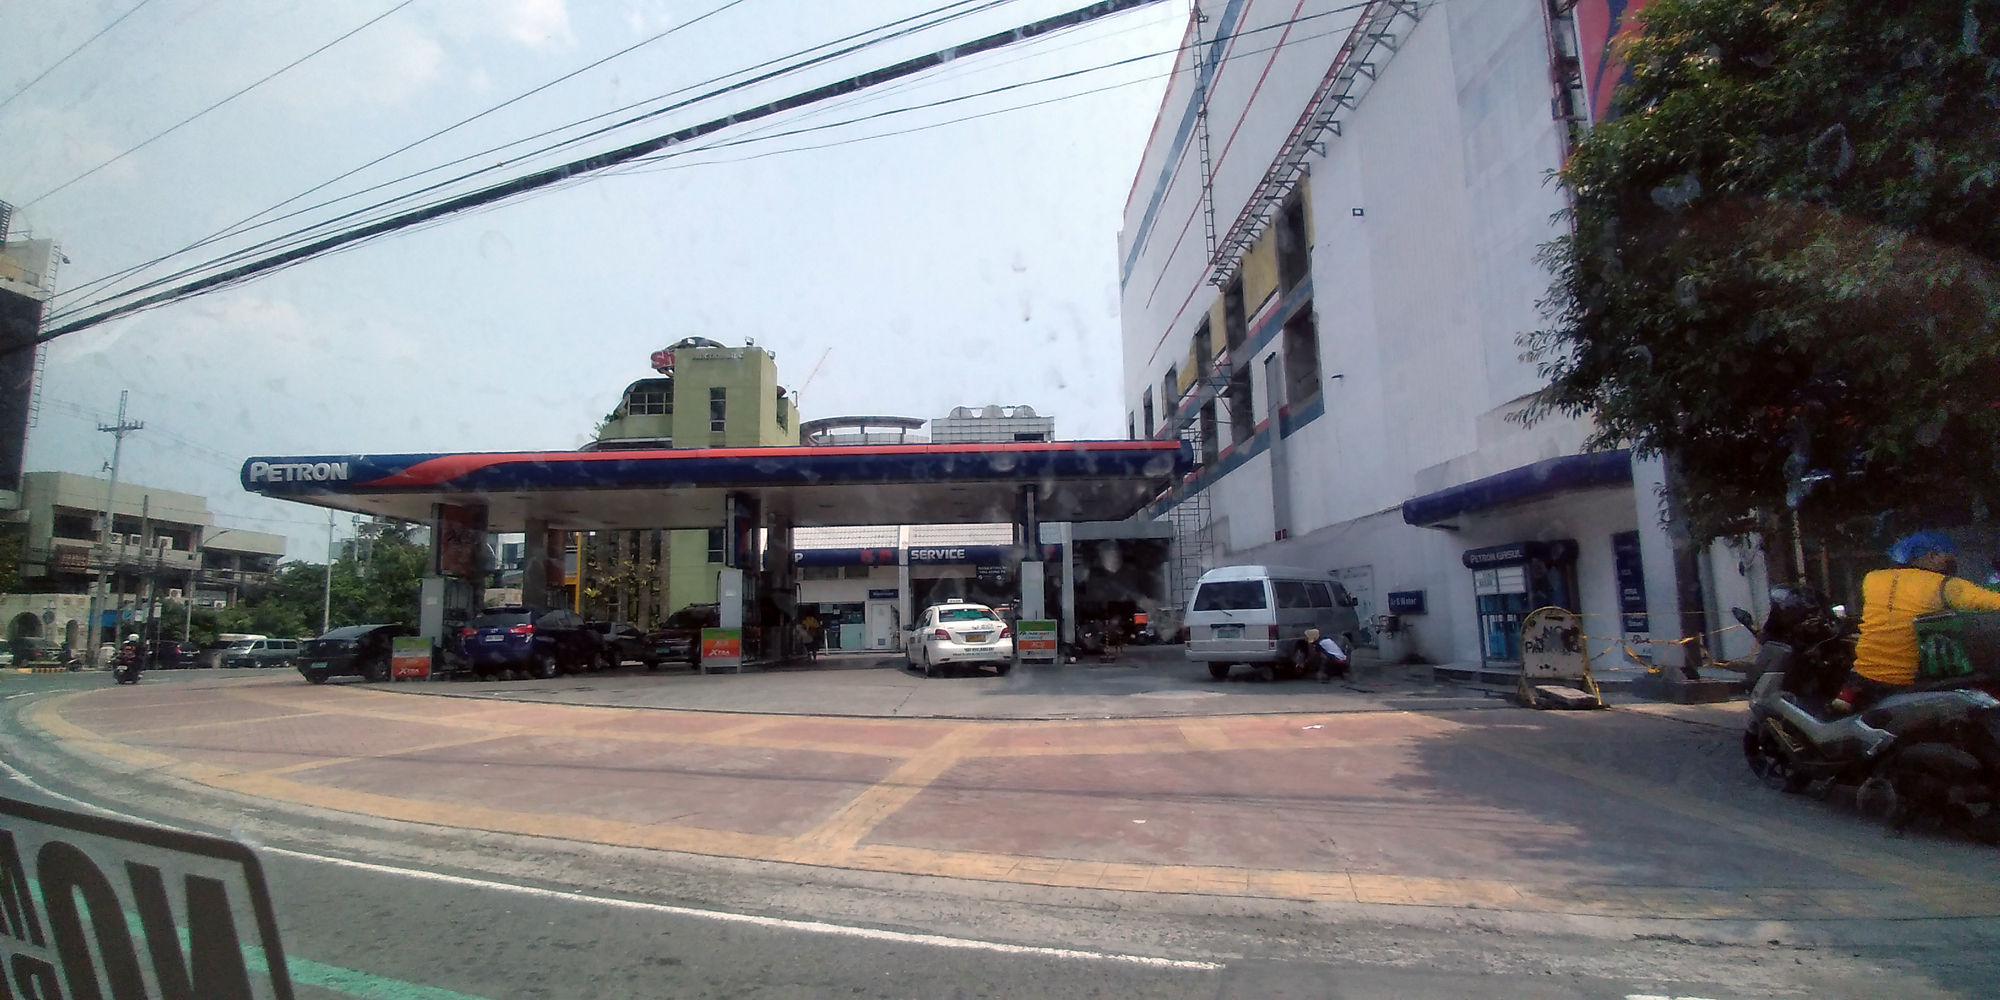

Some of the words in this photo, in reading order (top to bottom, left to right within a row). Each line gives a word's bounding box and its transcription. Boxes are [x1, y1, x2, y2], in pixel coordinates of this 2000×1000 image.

[250, 461, 349, 483] PETRON
[910, 549, 966, 560] SERVICE
[1469, 553, 1496, 564] PETRON
